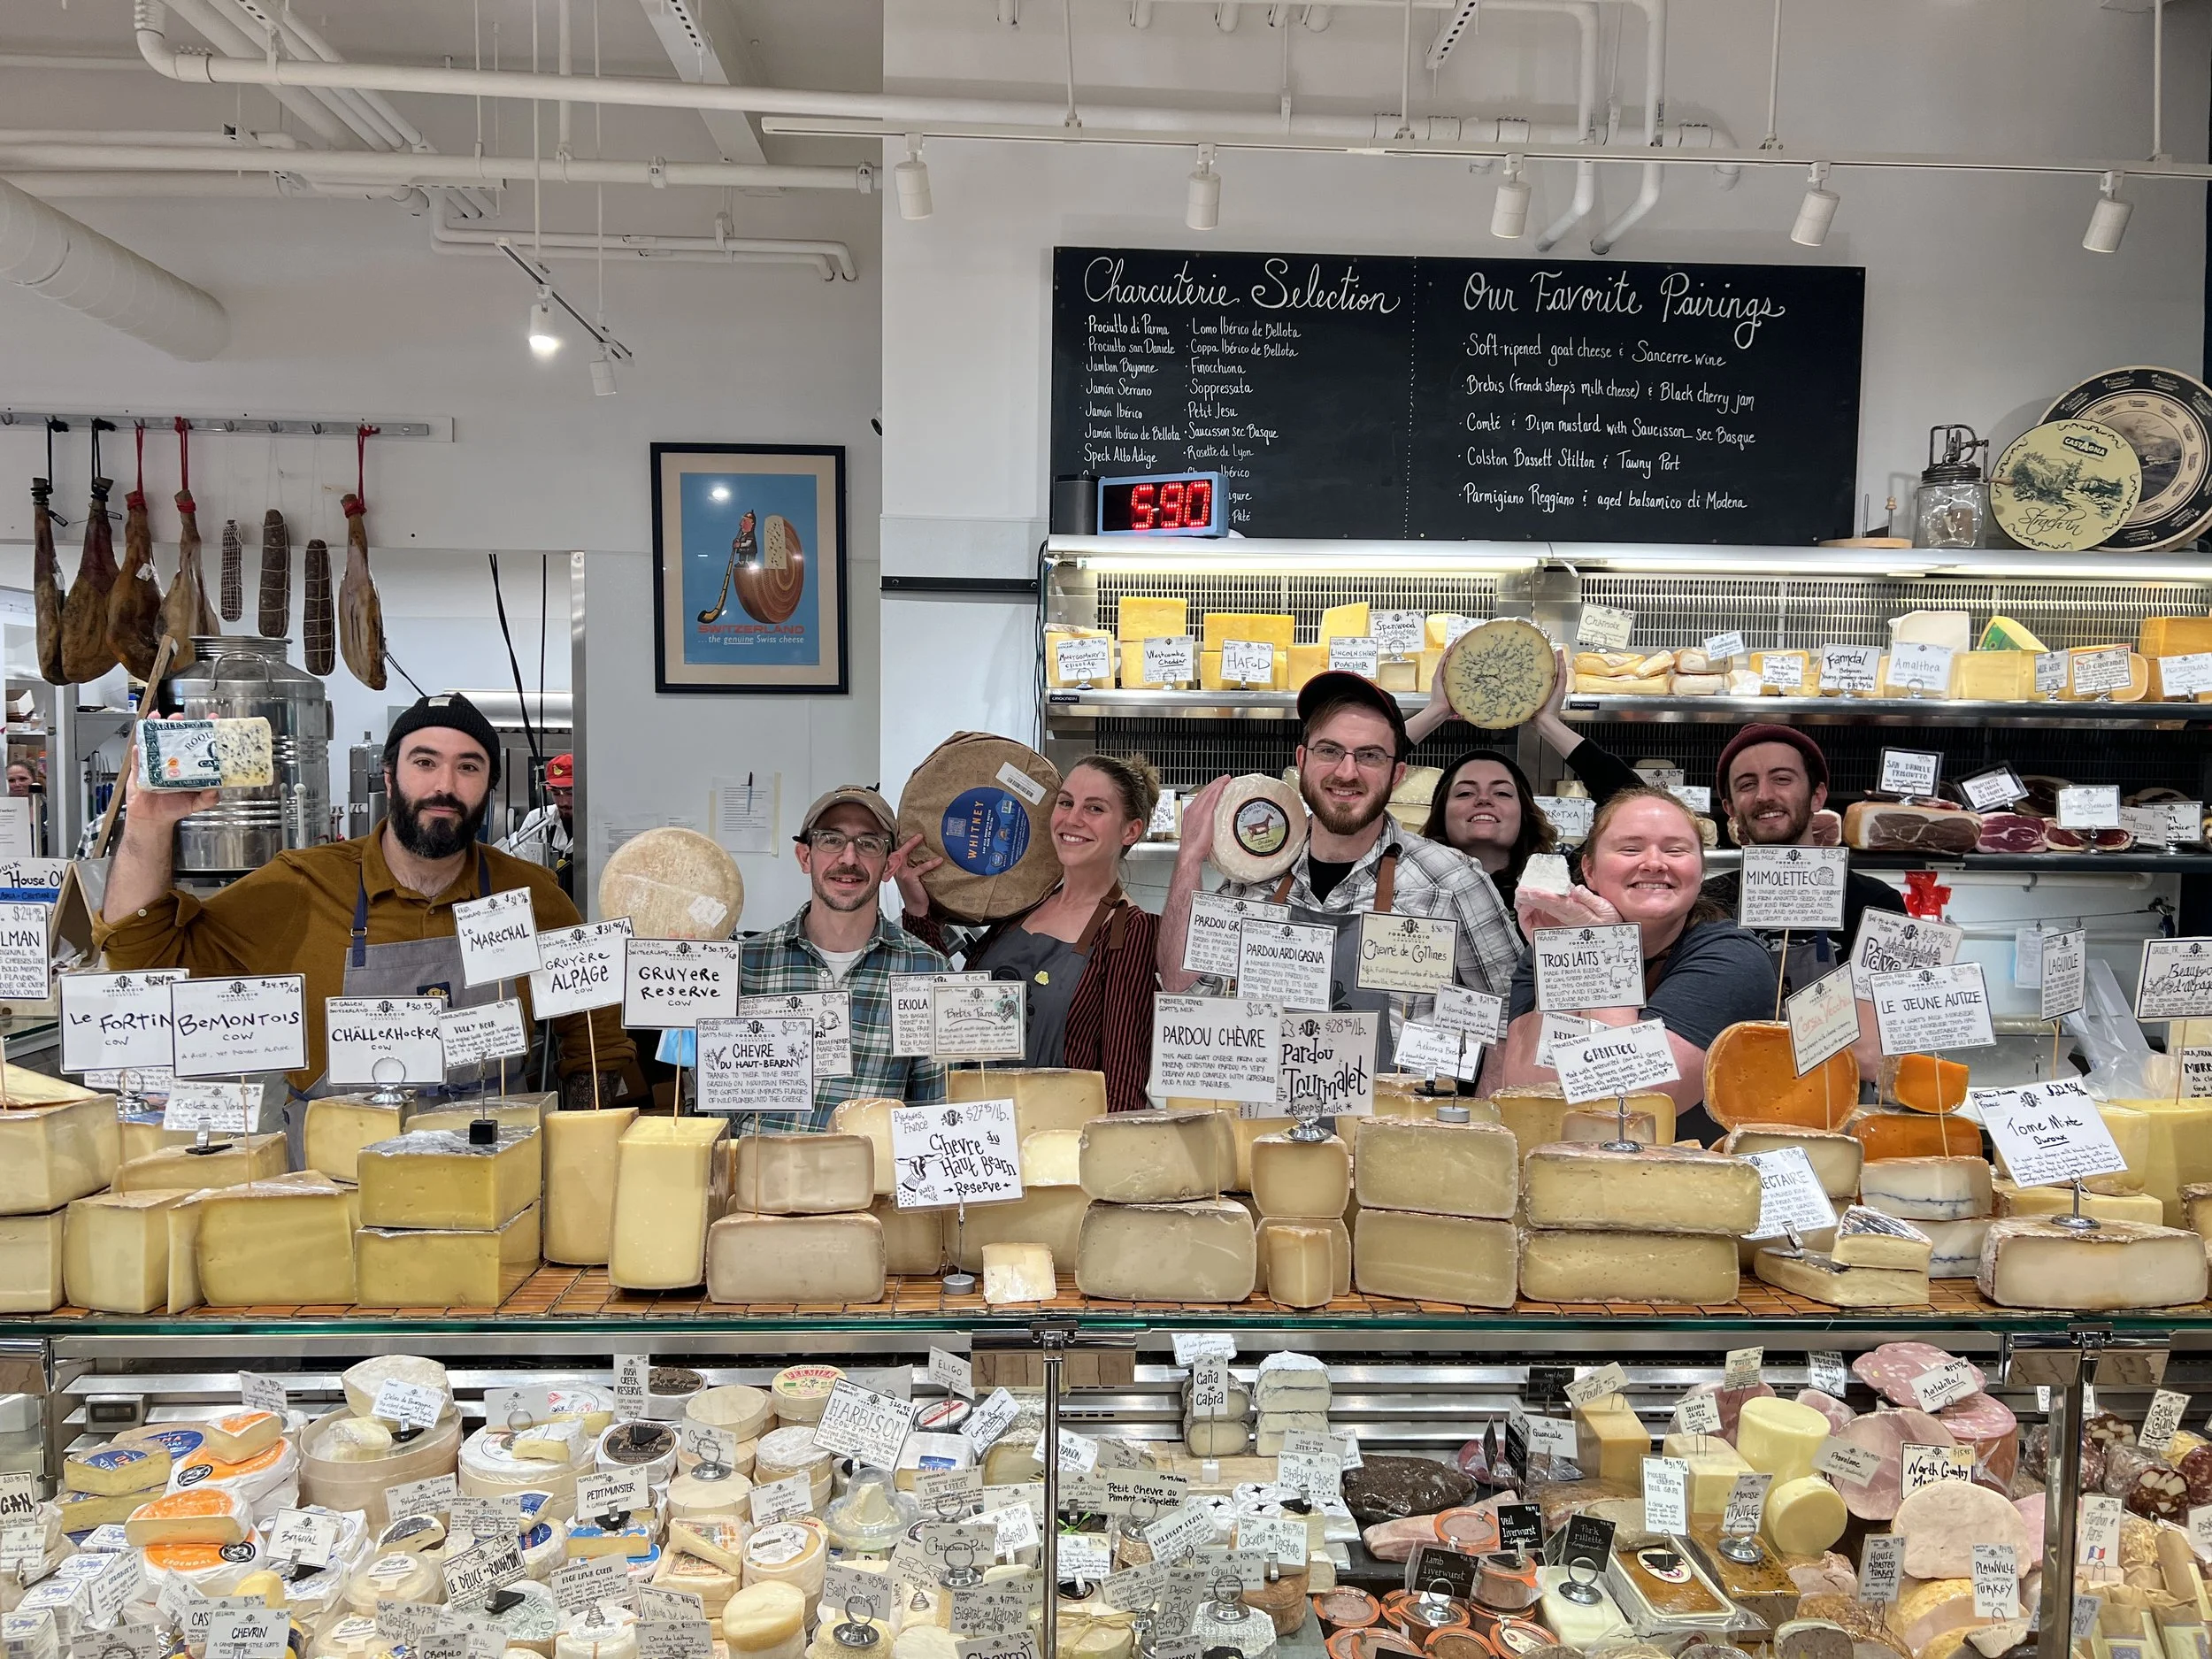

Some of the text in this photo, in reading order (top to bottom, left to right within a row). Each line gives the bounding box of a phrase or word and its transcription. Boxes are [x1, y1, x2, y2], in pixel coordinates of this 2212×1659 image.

[1084, 257, 1401, 314] Charcuterie Selection
[1463, 270, 1786, 349] Our Favorite Pairings
[1088, 313, 1170, 334] Prociutto di Parma
[1193, 315, 1302, 339] Lomo Ibérico de Bellota
[1088, 335, 1175, 354] Prociutto san Daniele
[1190, 338, 1298, 357] Coppa Ibérico de Bellota
[1467, 333, 1726, 366] Soft-ripened goat cheese Sancerre wine
[1086, 355, 1158, 379] Jambon Bayonne
[1191, 357, 1246, 374] Finocchiona
[1086, 378, 1152, 396] Jamón Serrano
[1190, 377, 1253, 401] Soppressata
[1466, 373, 1755, 414] Brebis (French sheep's milk cheese) Black cherry jam
[1085, 401, 1142, 419] Jamón Ibérico
[1188, 401, 1238, 419] Petit Jesu
[1085, 423, 1180, 441] Jamón Ibérico de Bellota
[1188, 421, 1279, 445] Saucisson sec Basque
[1467, 412, 1755, 450] Comté Dijon mustard with Saucisson sec Basque
[1187, 443, 1254, 461] Rosette de Lyon
[2064, 438, 2105, 456] CASTAGNA
[1084, 443, 1157, 470] Speck Alto Adige
[1467, 447, 1681, 480] Colston Bassett Stilton Tawny Port
[1463, 482, 1747, 513] Parmigiano Reggiano aged balsamico di Modena
[1232, 509, 1251, 523] Pâté
[697, 625, 804, 634] SWITZERLAND
[1895, 658, 1940, 672] Amalthea
[968, 801, 984, 859] WHITNEY
[1747, 871, 1809, 886] MIMOLETTE
[1247, 943, 1278, 957] PARDOU
[1401, 944, 1409, 956] de
[1540, 950, 1599, 968] TROIS LAITS
[1881, 991, 1982, 1014] LE JEUNE AUTIZE
[1164, 1025, 1265, 1048] PARDOU CHÈVRE
[733, 1044, 774, 1058] CHEVRE
[2007, 1118, 2047, 1137] Tome
[930, 1131, 1000, 1157] Chevre du
[940, 1156, 1017, 1178] Haut Bearn
[954, 1181, 1002, 1195] Reserve
[938, 1359, 963, 1376] ELIGO
[1196, 1370, 1219, 1386] Caña
[618, 1386, 642, 1395] RESERVE
[1196, 1391, 1224, 1407] Cabra
[829, 1398, 905, 1441] HARBISON
[1909, 1456, 1938, 1476] North
[1107, 1482, 1129, 1493] Petit
[1133, 1485, 1164, 1495] Chevre
[1108, 1493, 1136, 1502] Piment
[448, 1579, 457, 1594] LE
[1974, 1583, 2013, 1598] TURKEY
[231, 1626, 268, 1640] CHEVRIN
